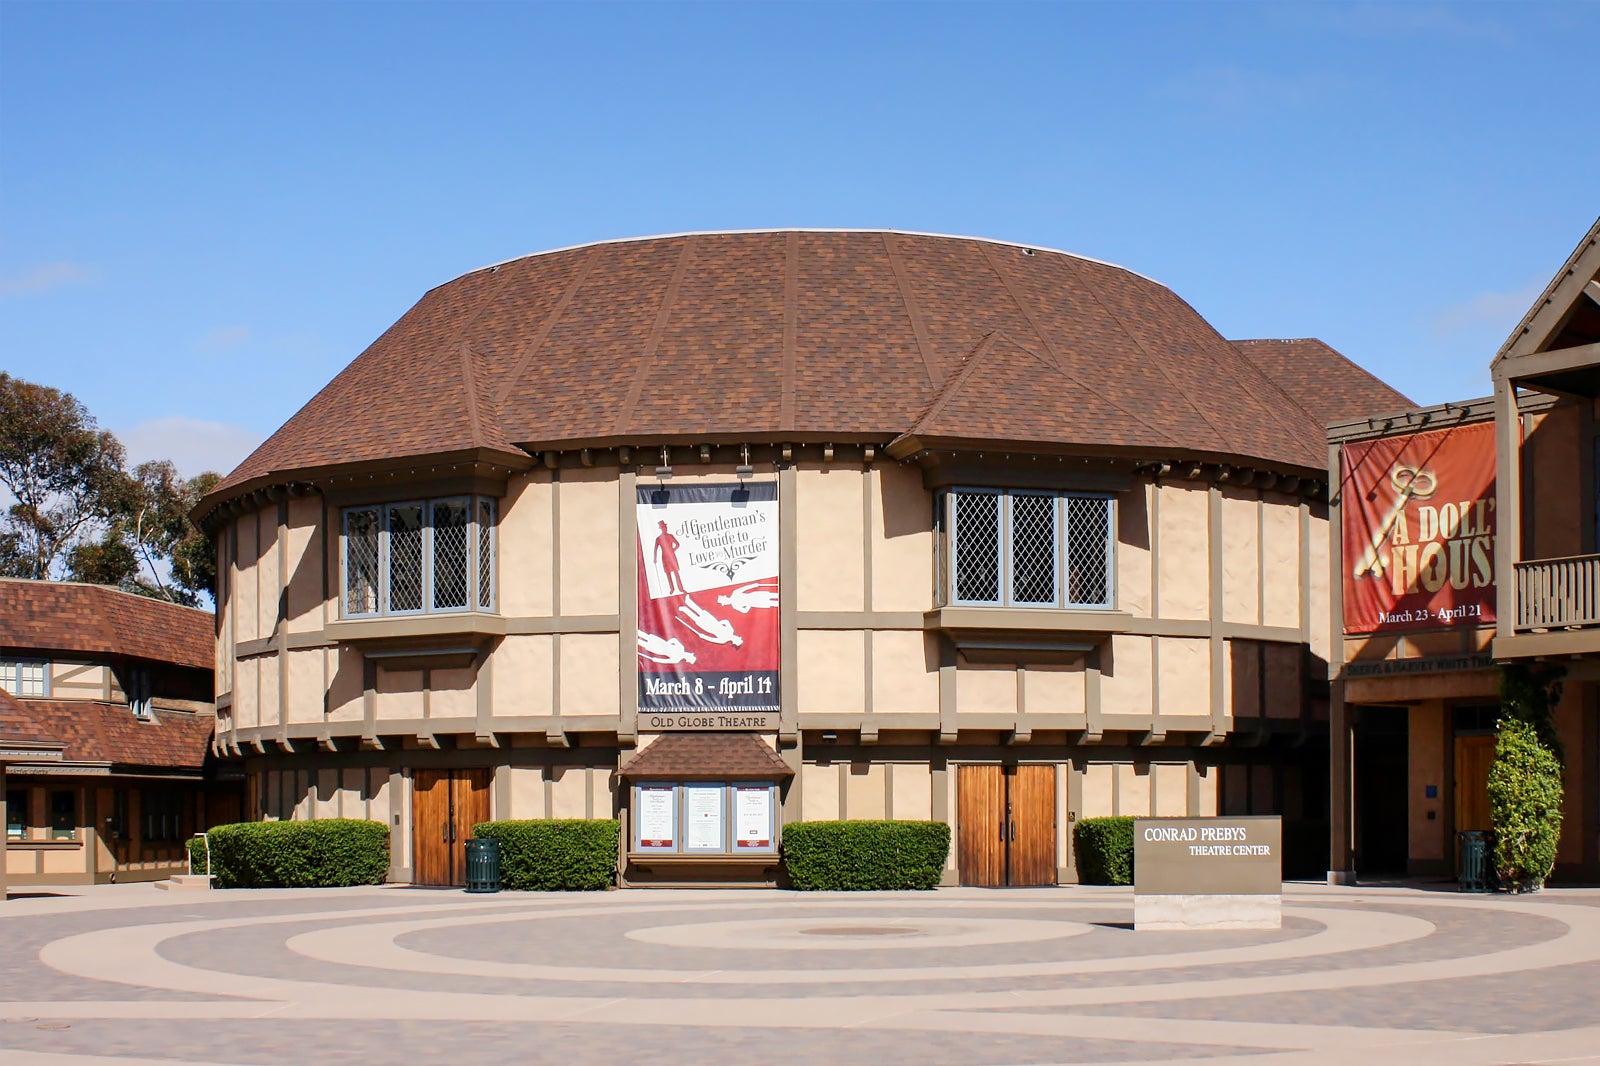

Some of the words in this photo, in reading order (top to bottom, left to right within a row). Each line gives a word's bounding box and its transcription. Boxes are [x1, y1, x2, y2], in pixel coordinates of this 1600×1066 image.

[676, 520, 690, 538] A
[690, 510, 766, 540] Gentleman's
[1392, 509, 1410, 545] A
[1418, 497, 1496, 543] DOLL'
[702, 531, 736, 549] Guide
[737, 530, 749, 542] to
[689, 550, 715, 566] Love
[723, 536, 767, 560] Murder
[1391, 535, 1497, 596] HOUS
[1379, 610, 1412, 624] March
[1415, 609, 1428, 621] 23
[1438, 605, 1466, 622] April
[1468, 604, 1482, 616] 21
[645, 676, 691, 695] March
[695, 677, 703, 695] 8
[719, 675, 753, 699] April
[757, 676, 772, 694] 14
[650, 717, 674, 728] OLD
[678, 717, 714, 728] GLOBE
[718, 716, 766, 727] THEATRE
[1144, 827, 1197, 842] CONRAD
[1200, 827, 1247, 841] PREBYS
[1189, 845, 1231, 856] THEATRE
[1232, 845, 1271, 856] CENTER
